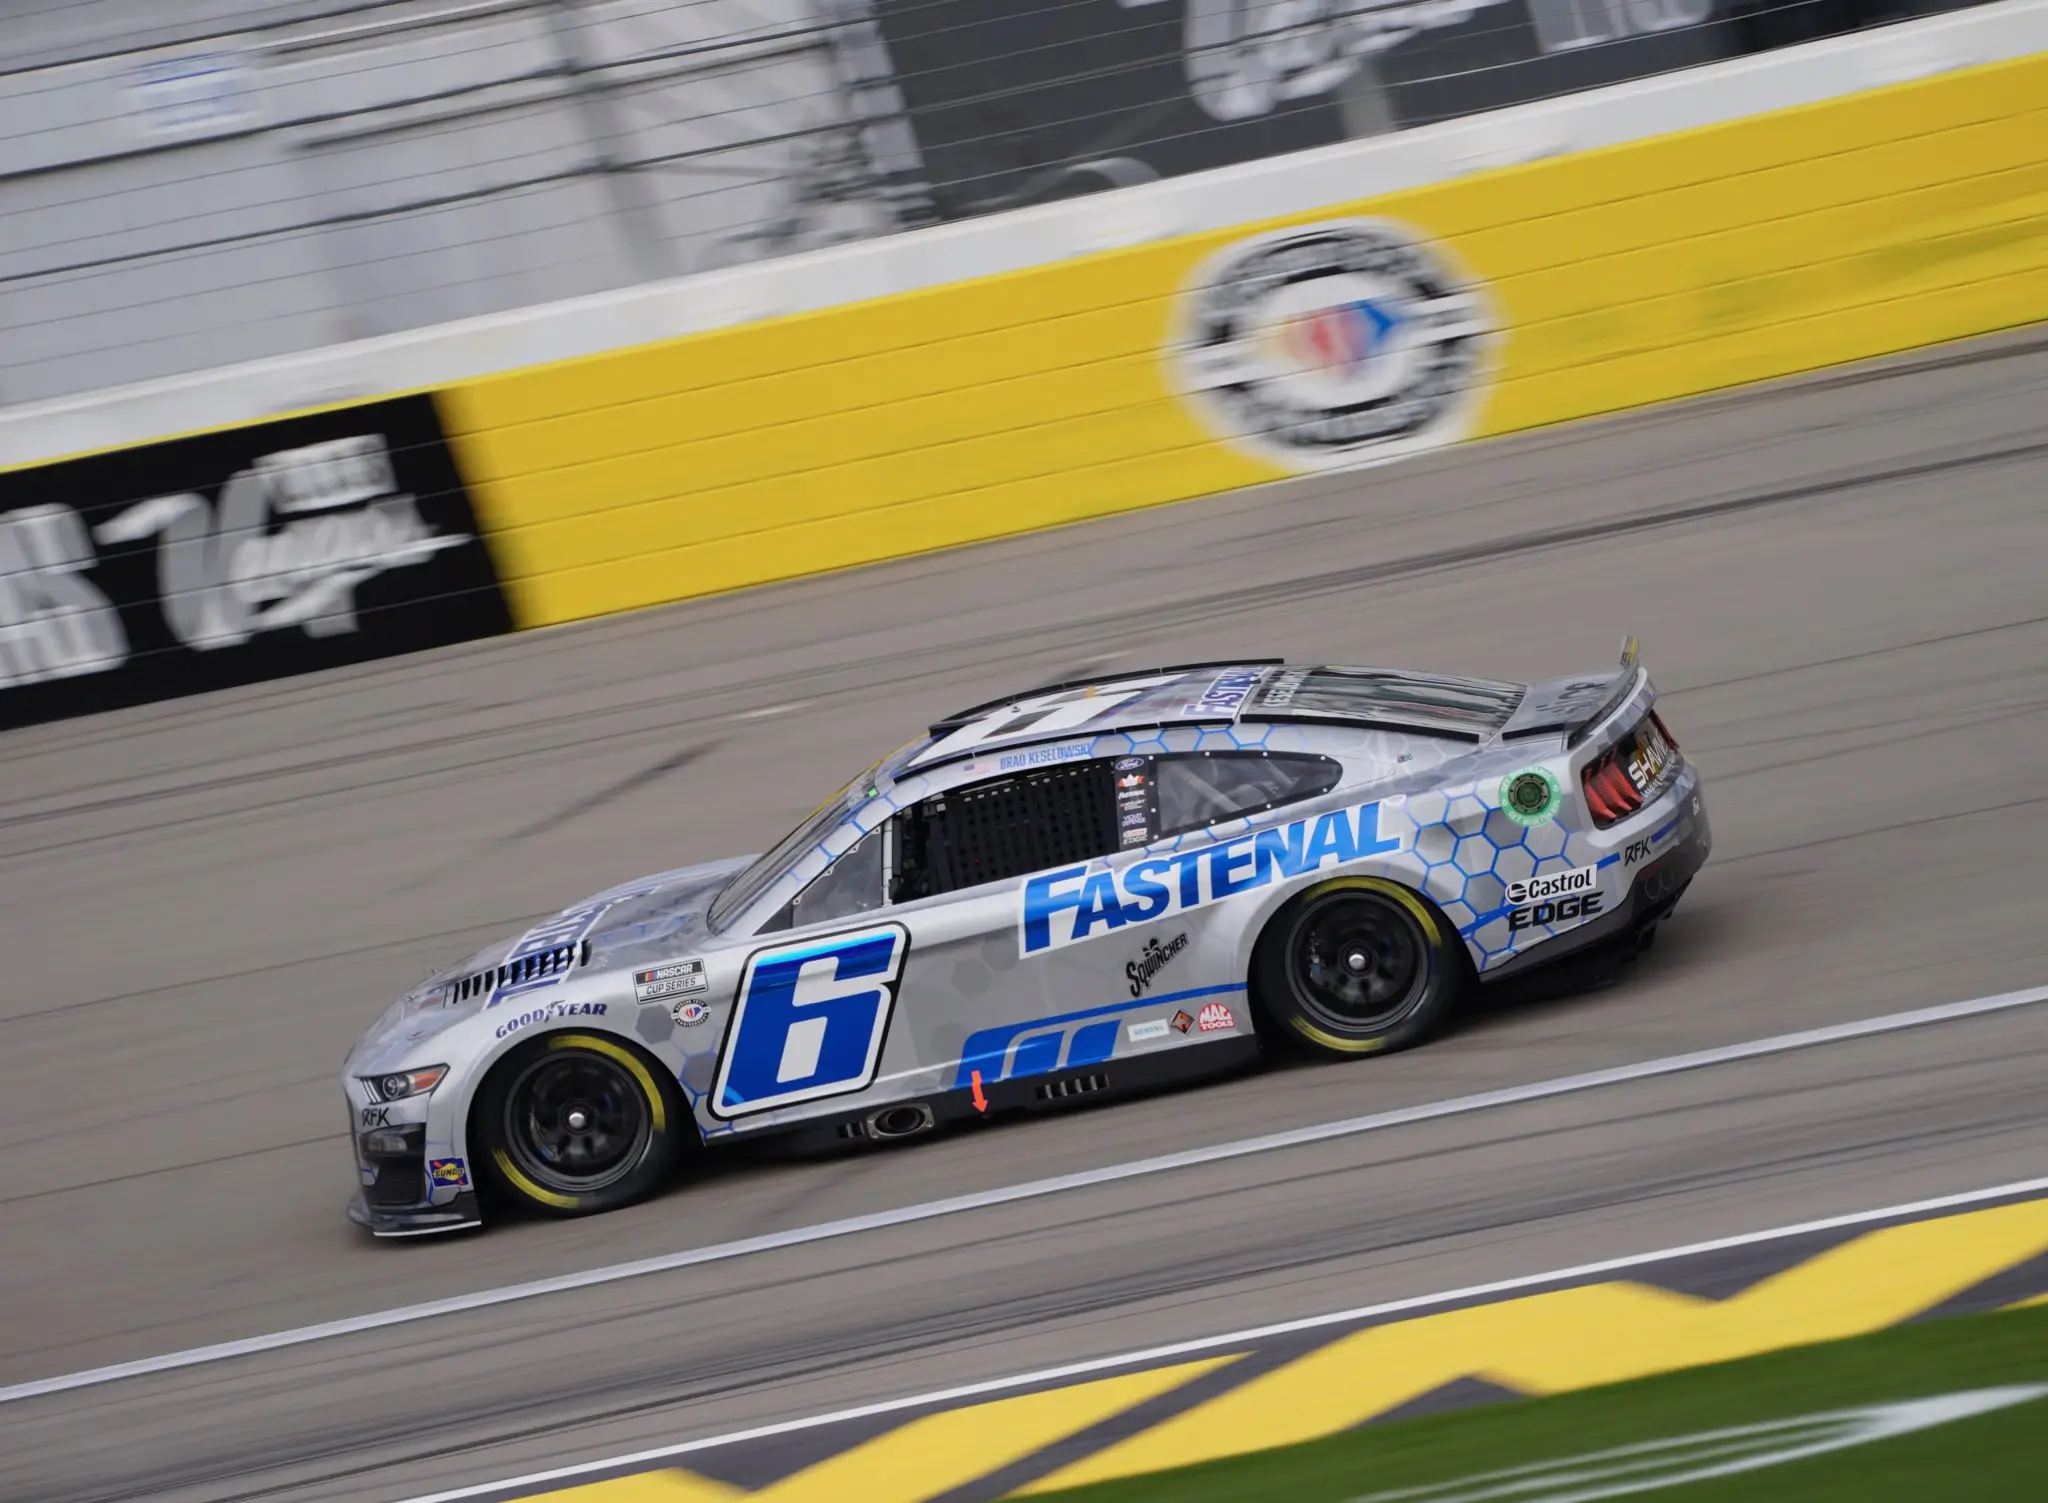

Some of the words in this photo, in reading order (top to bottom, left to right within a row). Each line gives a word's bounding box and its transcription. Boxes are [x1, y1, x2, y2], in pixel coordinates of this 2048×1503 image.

[1000, 755, 1026, 770] BRAD
[1029, 743, 1091, 765] KESELOWSKI
[1624, 837, 1651, 867] RFK
[1024, 801, 1401, 954] FASTENAL
[1528, 869, 1592, 899] Castrol
[1508, 891, 1604, 932] EDGE
[656, 963, 694, 981] NASCAR
[646, 983, 664, 995] CUP
[665, 977, 696, 992] SERIES
[495, 1000, 608, 1039] GOODYEAR
[713, 924, 907, 1118] 6
[1200, 1004, 1233, 1024] MAC
[1200, 1020, 1235, 1031] TOOLS
[1133, 1024, 1165, 1037] SIEMENS
[361, 1106, 392, 1127] RFK
[433, 1167, 465, 1179] SUNOCO
